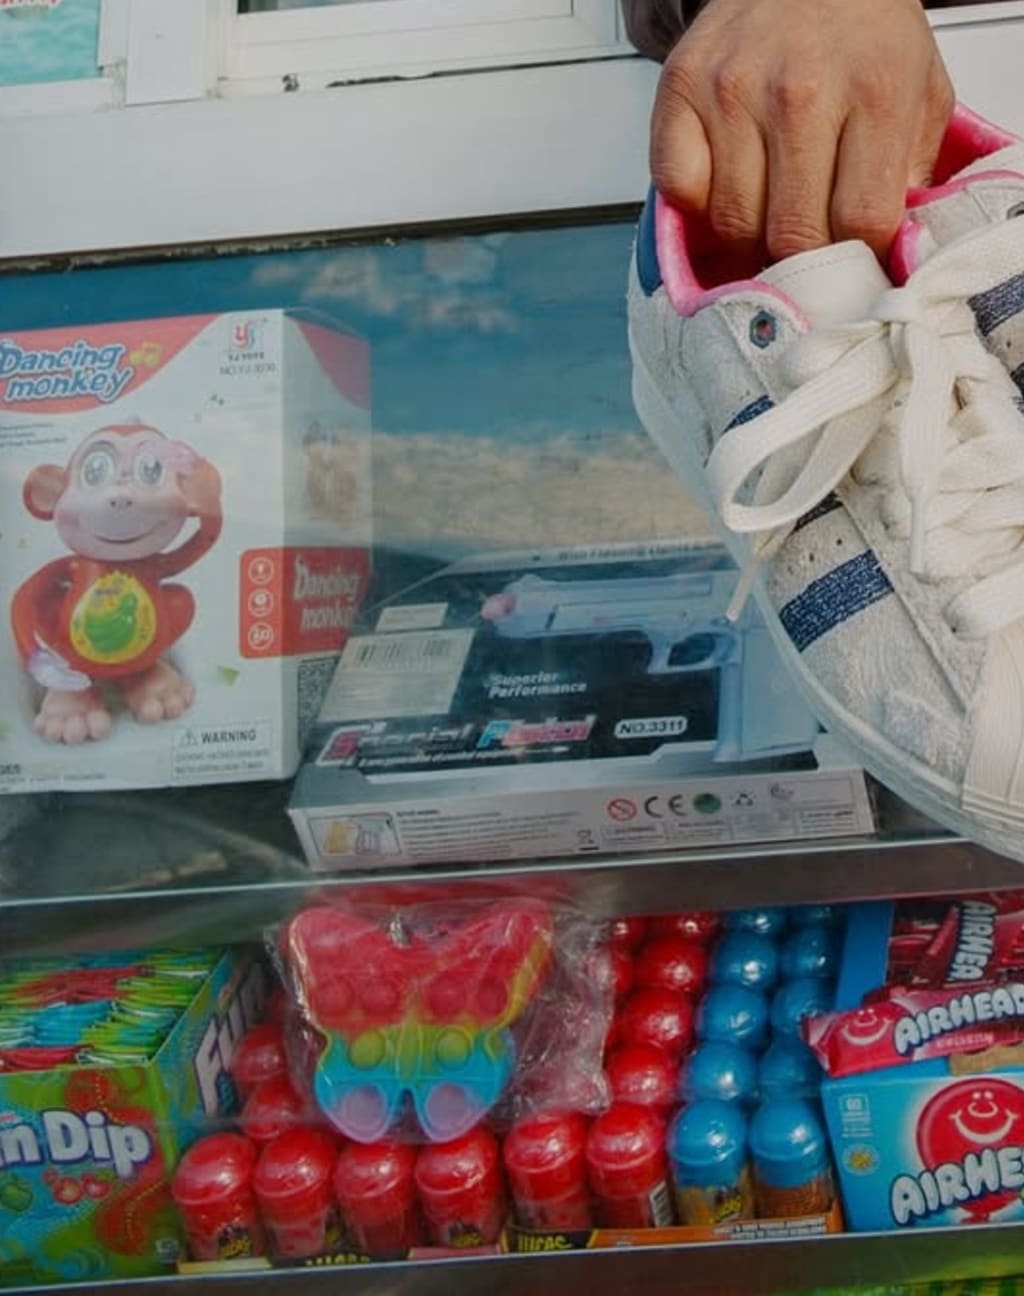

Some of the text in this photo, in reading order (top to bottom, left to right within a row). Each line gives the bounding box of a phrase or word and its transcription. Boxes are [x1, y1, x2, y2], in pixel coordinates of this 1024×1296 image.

[0, 339, 125, 377] Dancing
[5, 367, 133, 402] monkey
[490, 670, 560, 687] Superior
[488, 682, 588, 699] Performance
[617, 718, 684, 736] NO.3311
[200, 728, 257, 745] WARNING
[0, 1109, 150, 1180] n Dip
